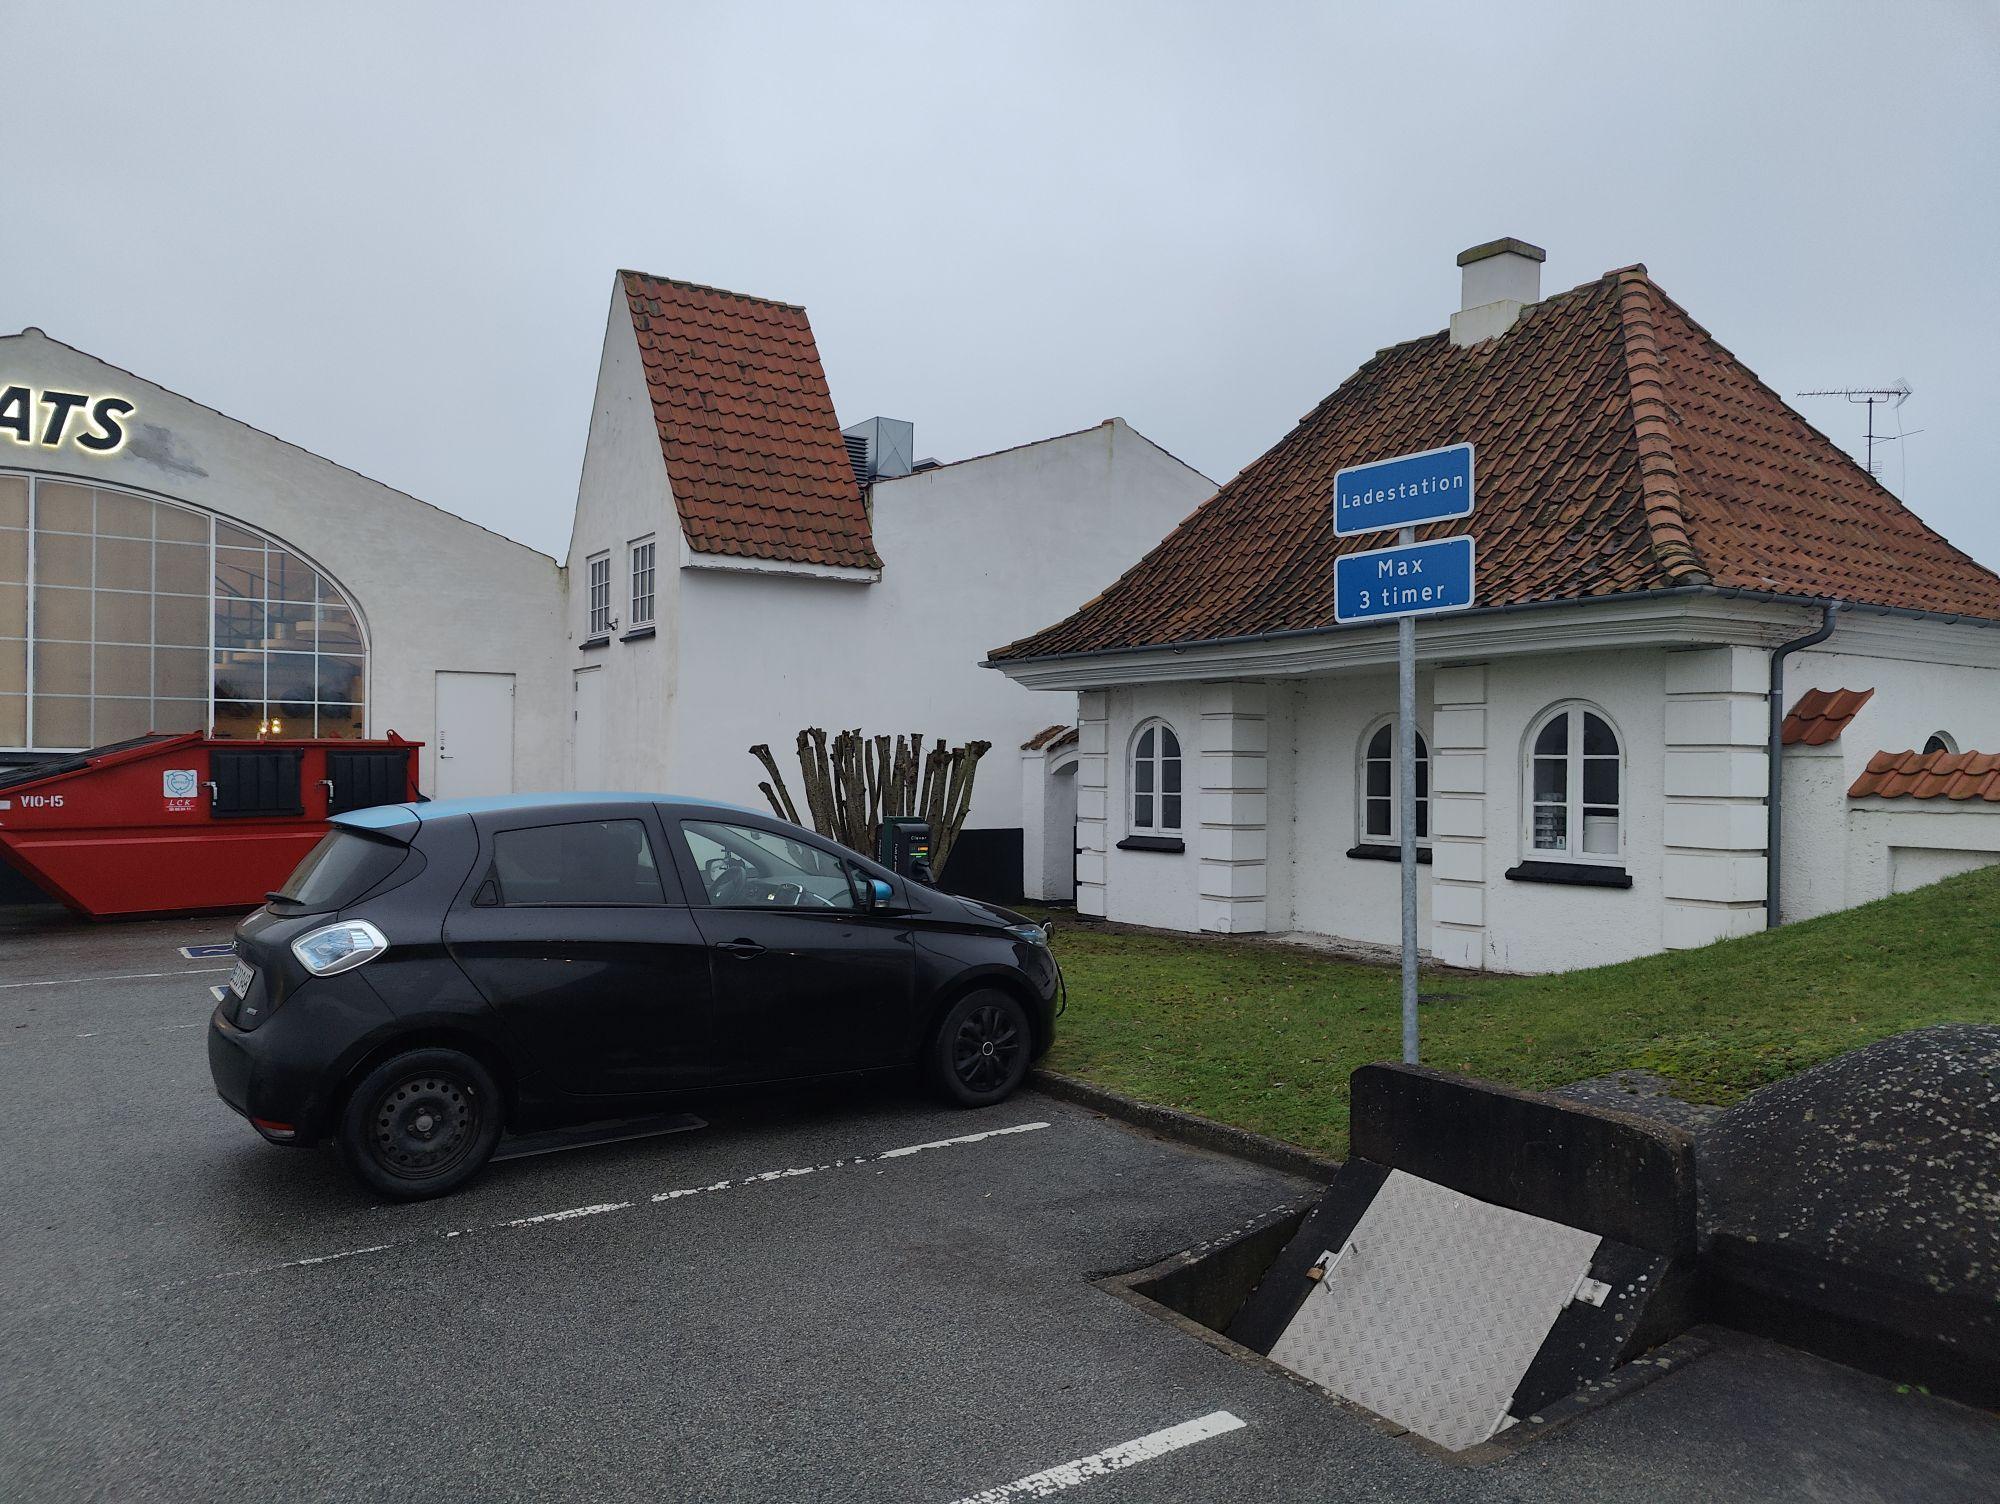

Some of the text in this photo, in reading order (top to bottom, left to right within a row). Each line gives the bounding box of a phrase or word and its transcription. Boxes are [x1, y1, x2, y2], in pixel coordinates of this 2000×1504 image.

[0, 386, 135, 450] ATS
[1342, 474, 1463, 509] Ladestation
[1378, 559, 1423, 579] Max
[1359, 584, 1445, 609] 3 timer
